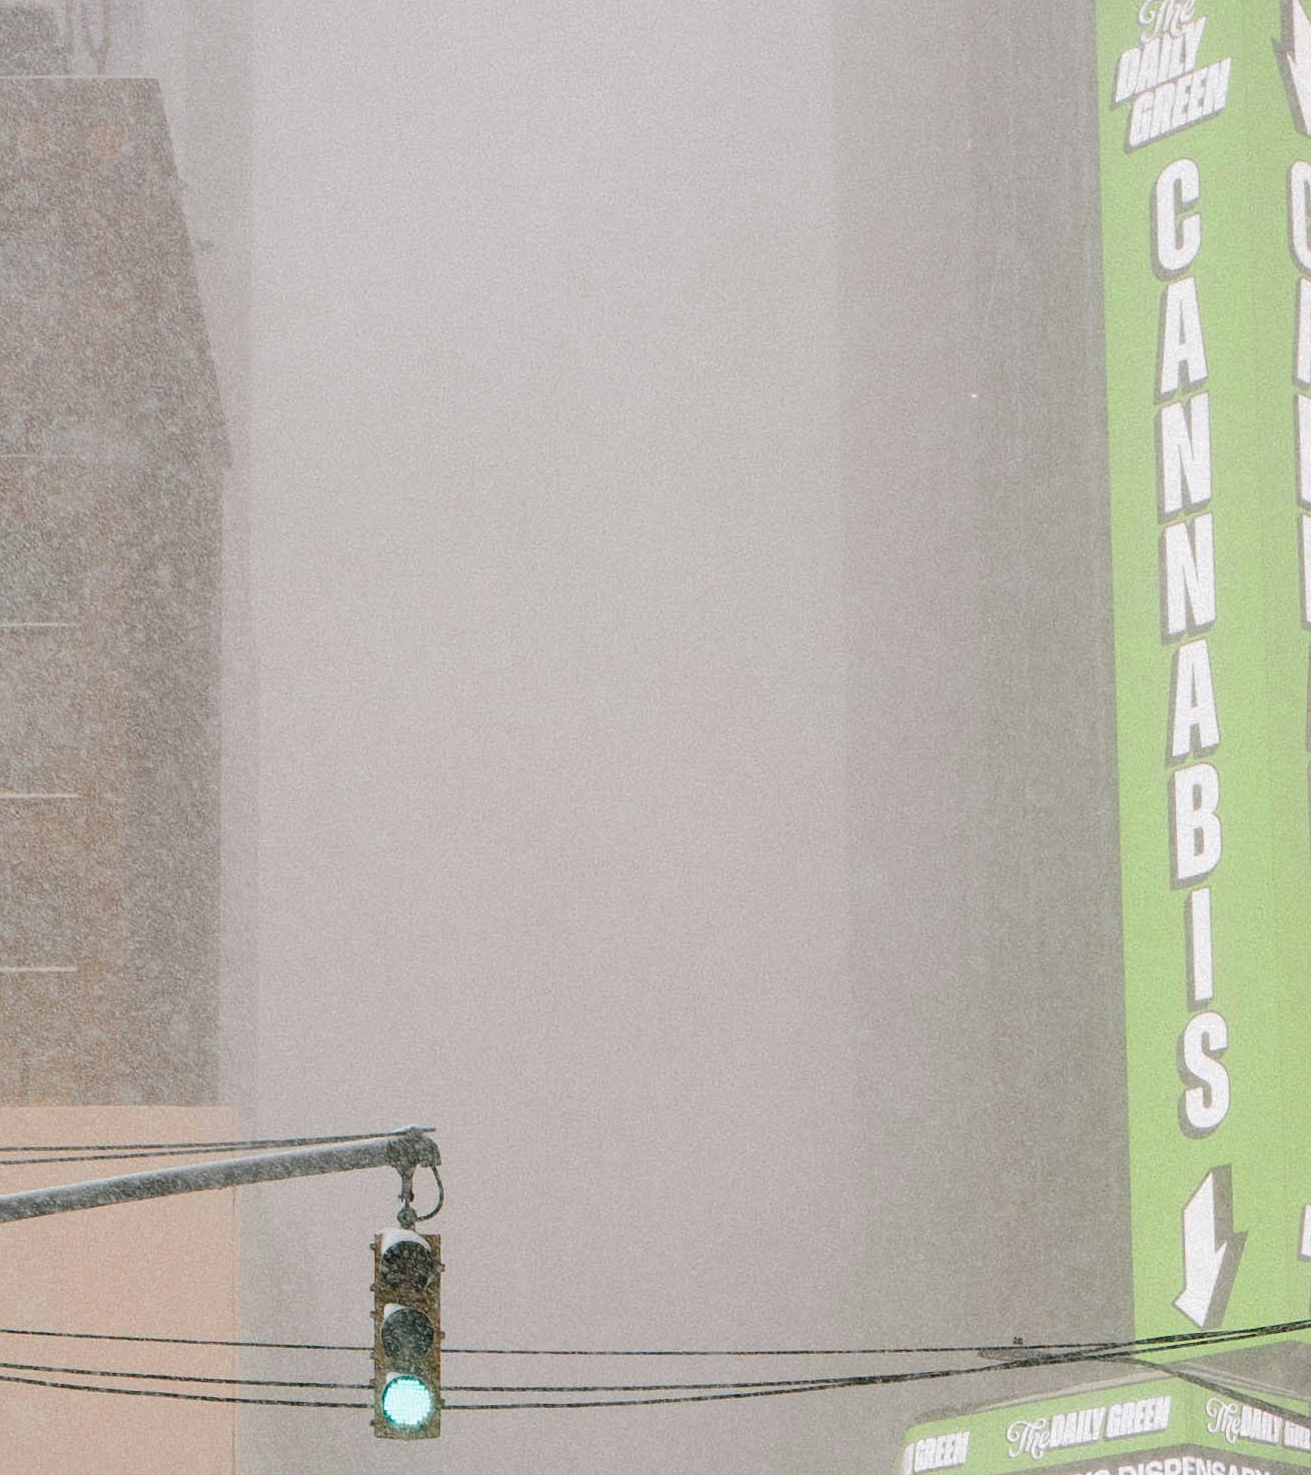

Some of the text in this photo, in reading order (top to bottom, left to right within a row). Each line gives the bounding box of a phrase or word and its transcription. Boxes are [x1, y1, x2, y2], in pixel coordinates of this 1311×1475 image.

[1115, 18, 1207, 103] DAILY
[1128, 57, 1232, 149] GREEN
[1155, 157, 1230, 1129] CANNABIS
[913, 1430, 971, 1474] GREEN
[1005, 1395, 1173, 1461] The DAILY GREEN
[1205, 1397, 1242, 1445] The
